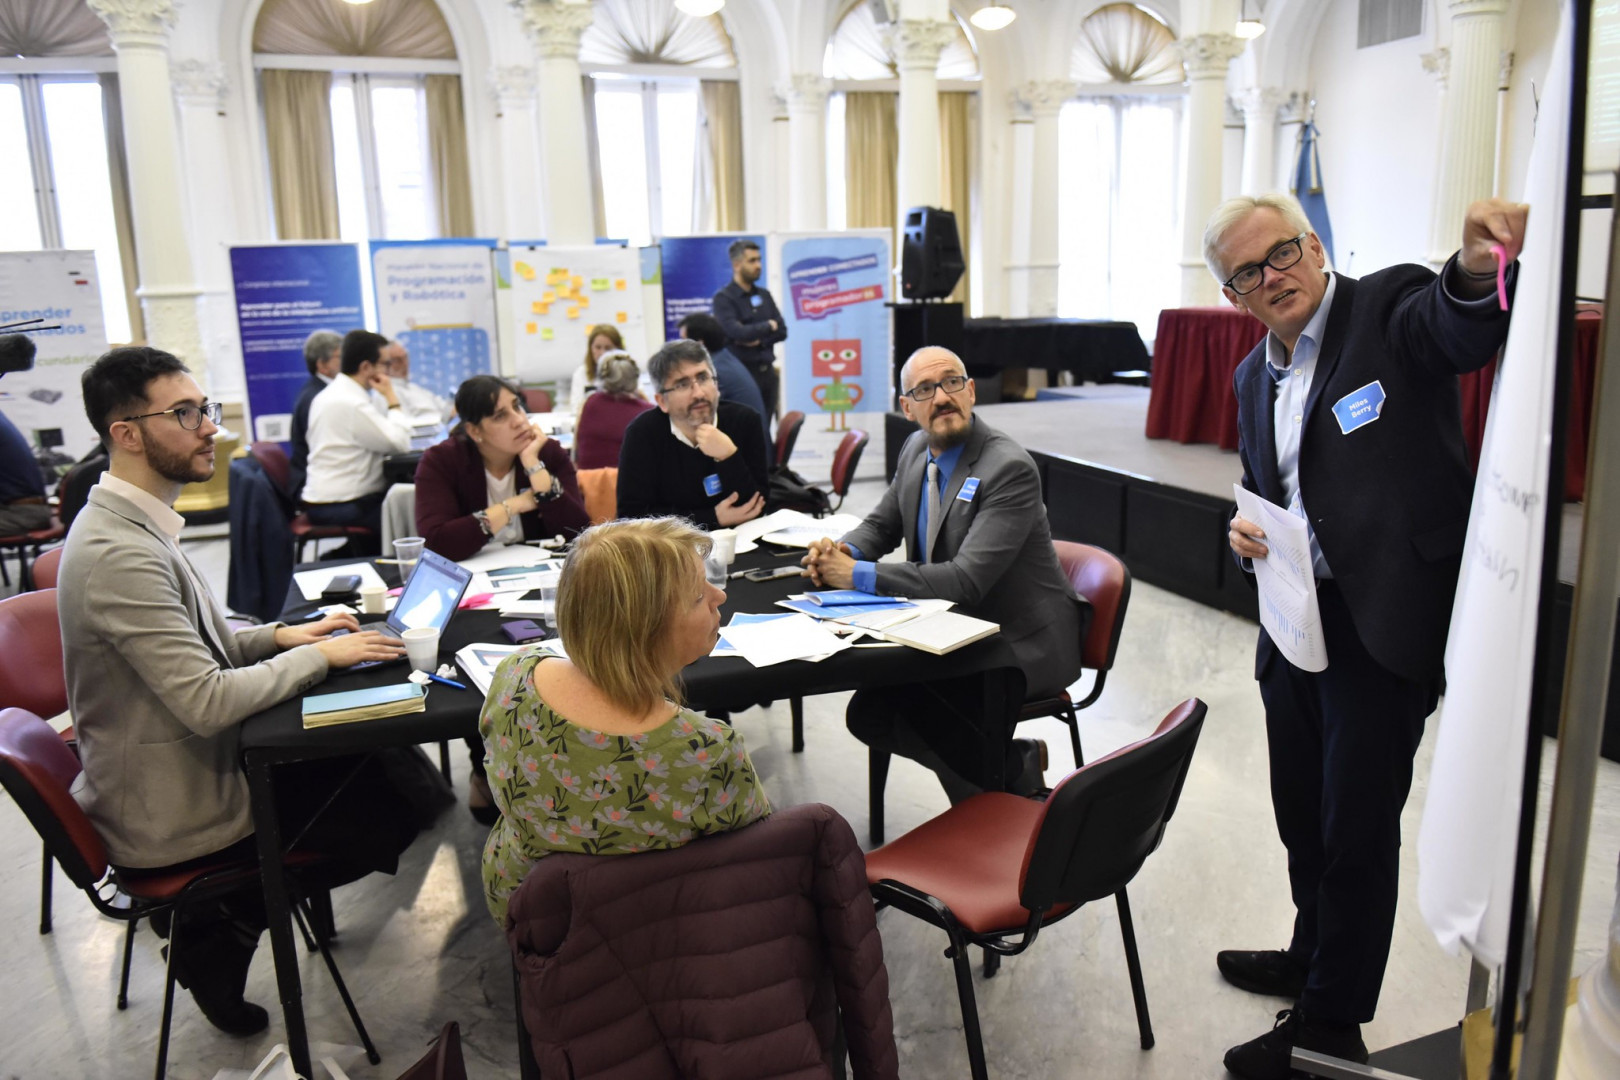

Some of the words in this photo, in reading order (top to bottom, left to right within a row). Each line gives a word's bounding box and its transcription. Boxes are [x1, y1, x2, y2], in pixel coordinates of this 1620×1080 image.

[388, 275, 484, 287] Programación
[403, 290, 466, 300] Robótica
[0, 307, 72, 321] prender
[1349, 398, 1369, 411] Miles
[1351, 405, 1372, 418] Berry
